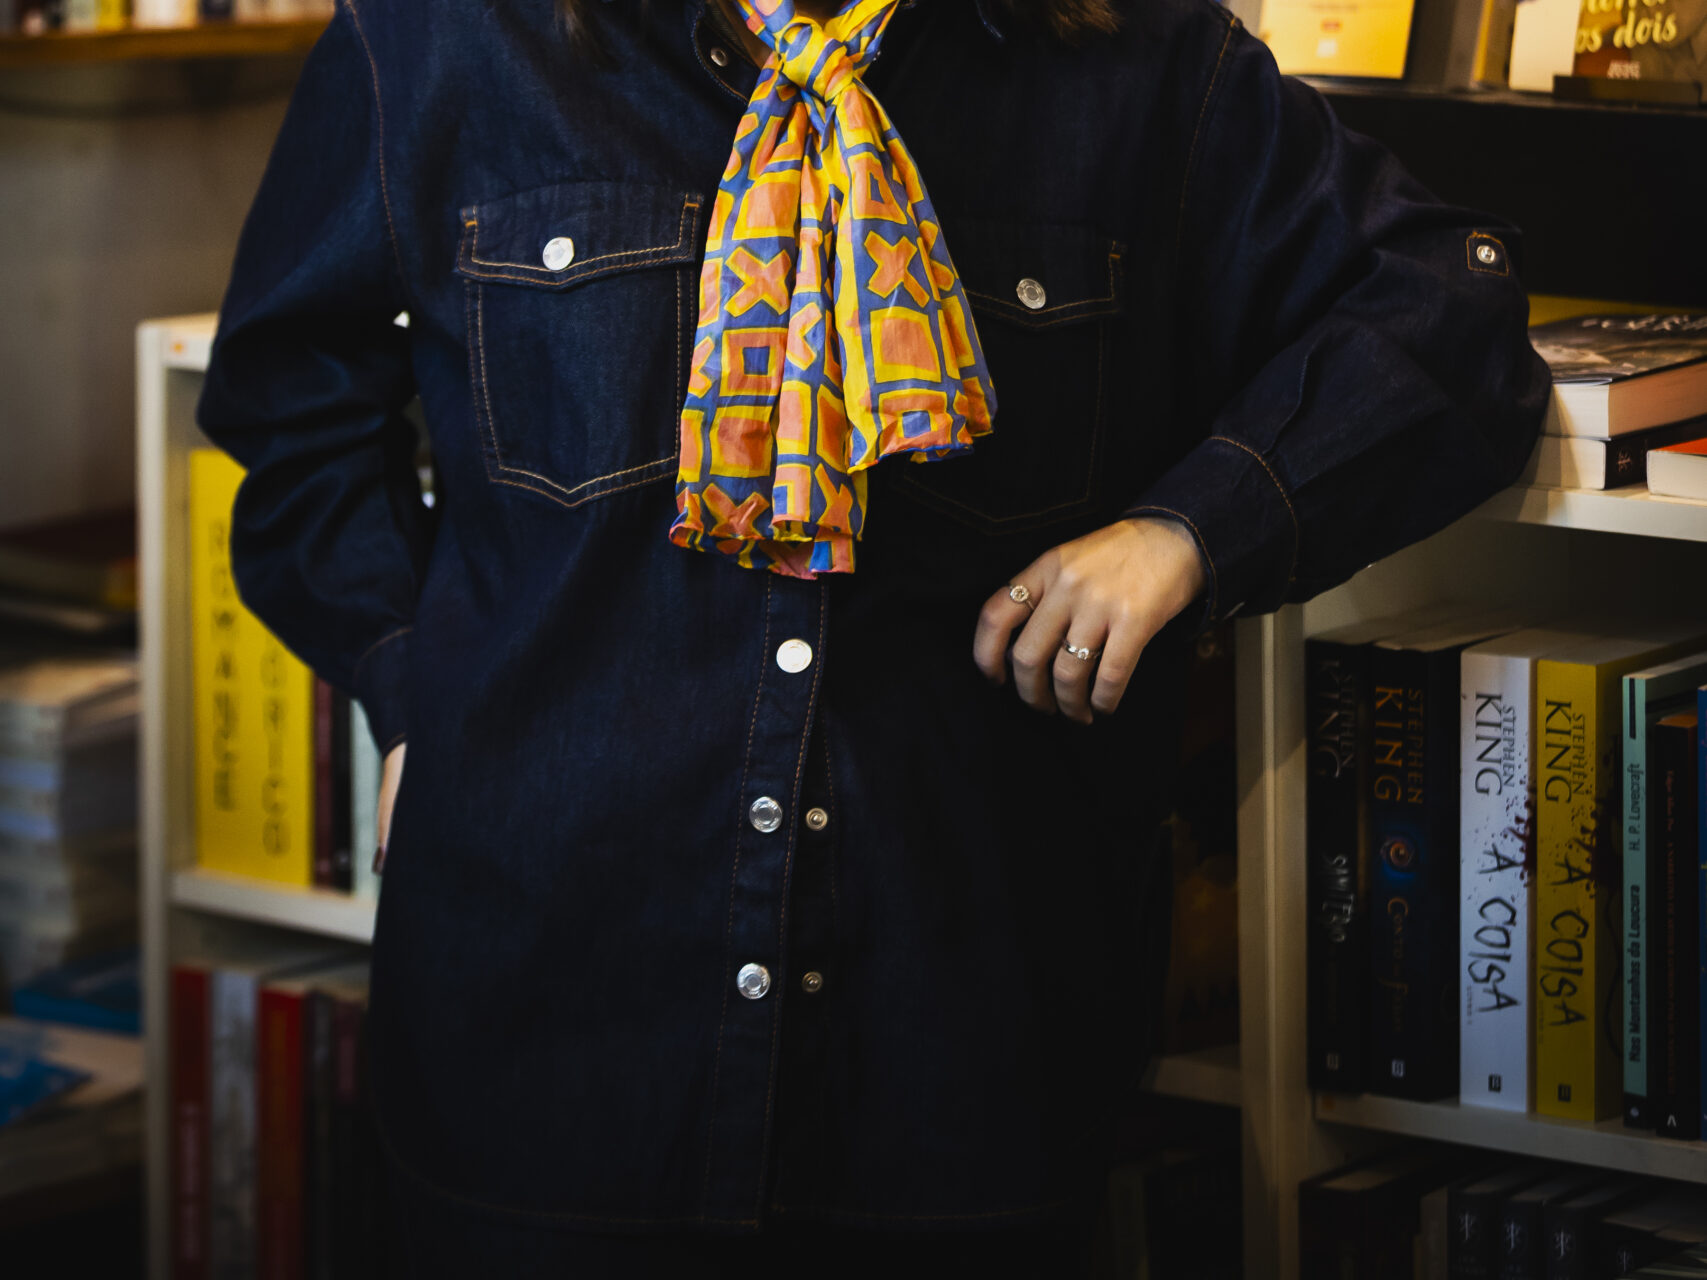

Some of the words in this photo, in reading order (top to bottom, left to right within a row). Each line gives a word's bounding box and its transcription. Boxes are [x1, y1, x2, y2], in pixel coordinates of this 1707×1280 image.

[1613, 9, 1677, 49] dois
[1317, 659, 1341, 780] KING
[1375, 685, 1404, 802] KING
[1407, 687, 1424, 804] STEPHEN
[1474, 693, 1503, 797] KING
[1502, 705, 1516, 788] STEPHEN
[1545, 700, 1573, 804] KING
[1573, 713, 1586, 796] STEPHEN
[1628, 763, 1644, 821] Lovecraft
[1478, 843, 1523, 875] A
[1552, 854, 1592, 886] A
[1628, 941, 1640, 958] da
[1629, 884, 1640, 938] Loucura
[1467, 897, 1522, 1013] COISA
[1540, 909, 1589, 1026] COISA
[1629, 960, 1640, 1034] Montanhas
[1629, 1037, 1640, 1063] Nas
